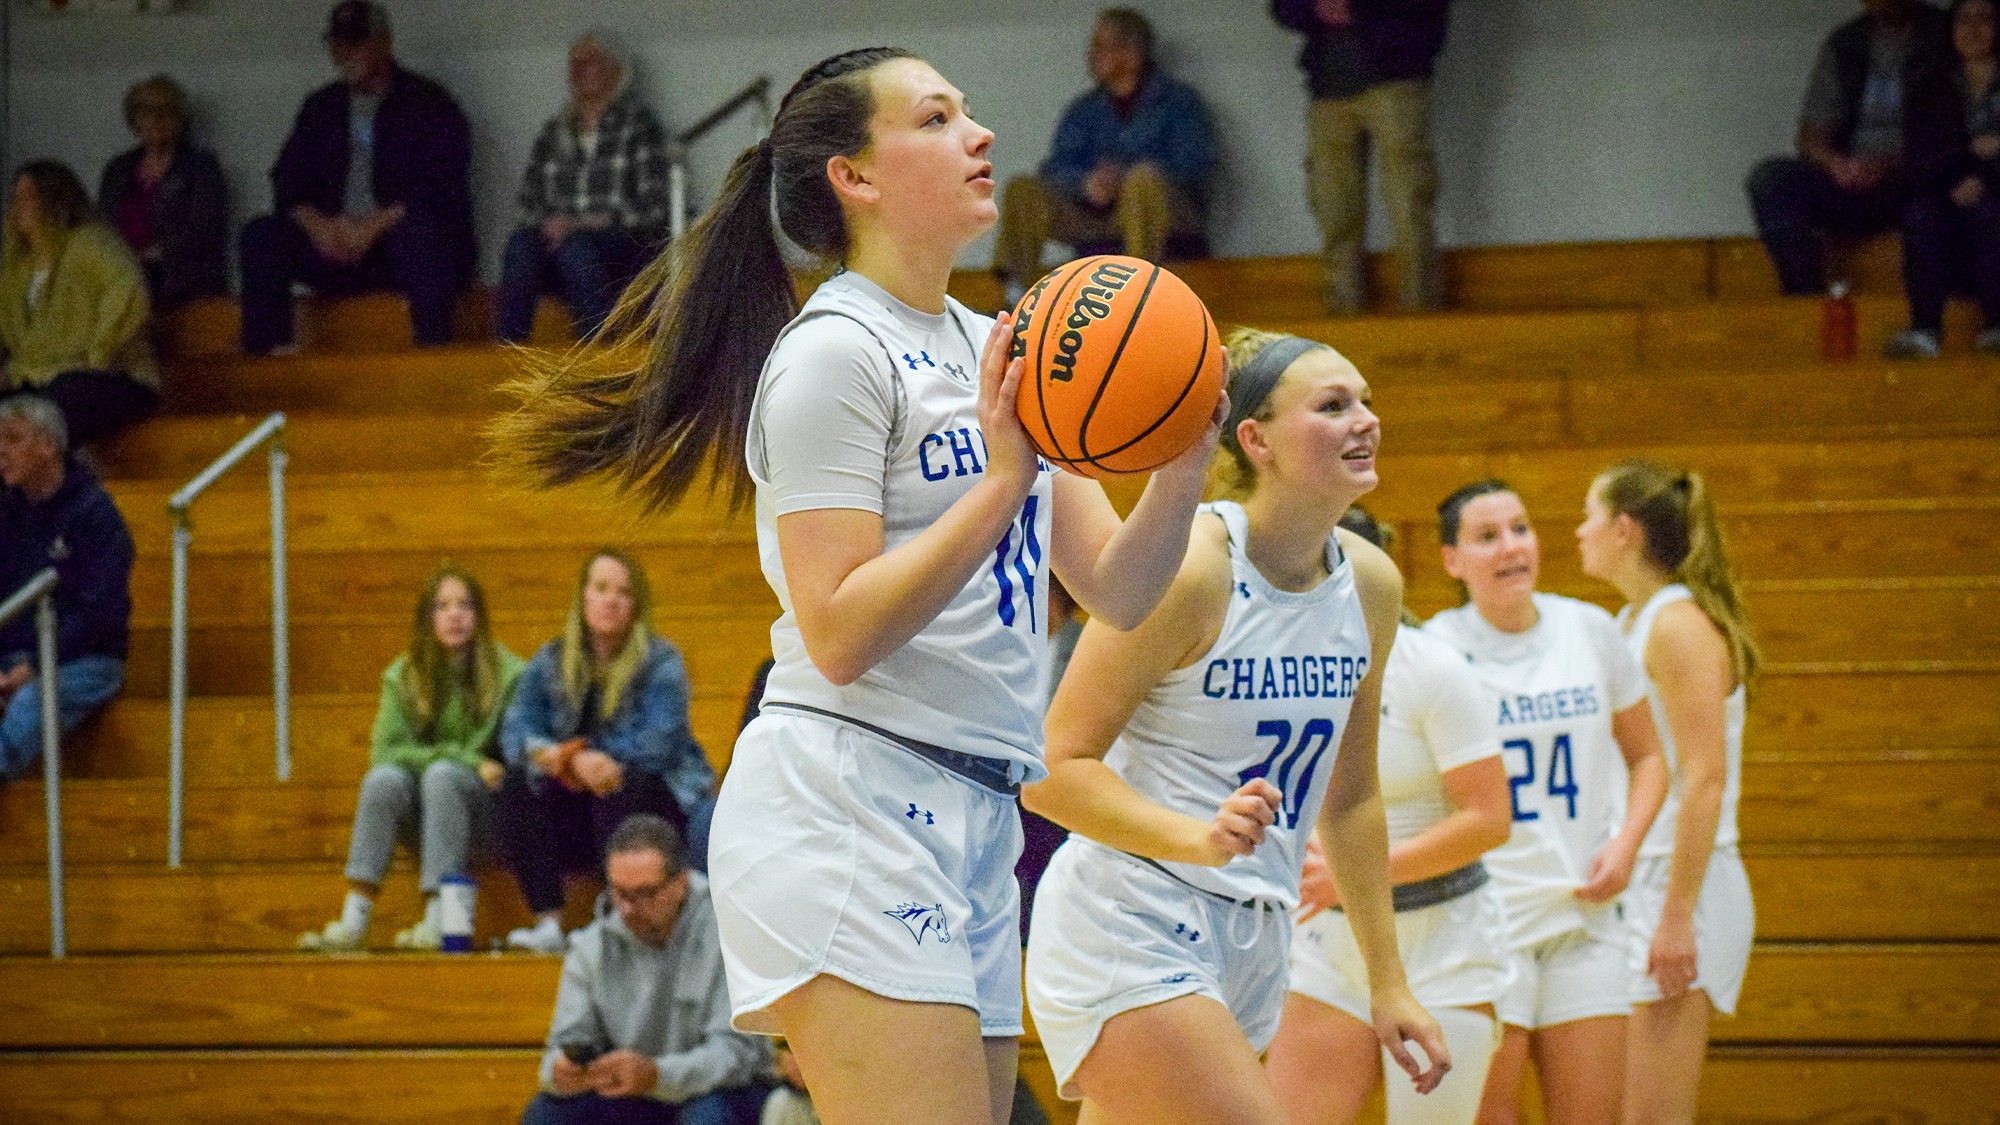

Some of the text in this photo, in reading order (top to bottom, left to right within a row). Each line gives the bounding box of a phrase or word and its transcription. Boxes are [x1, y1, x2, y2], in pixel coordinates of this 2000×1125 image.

[1050, 262, 1141, 383] Wilson
[1497, 684, 1599, 726] ARGERS
[1502, 733, 1579, 823] 24
